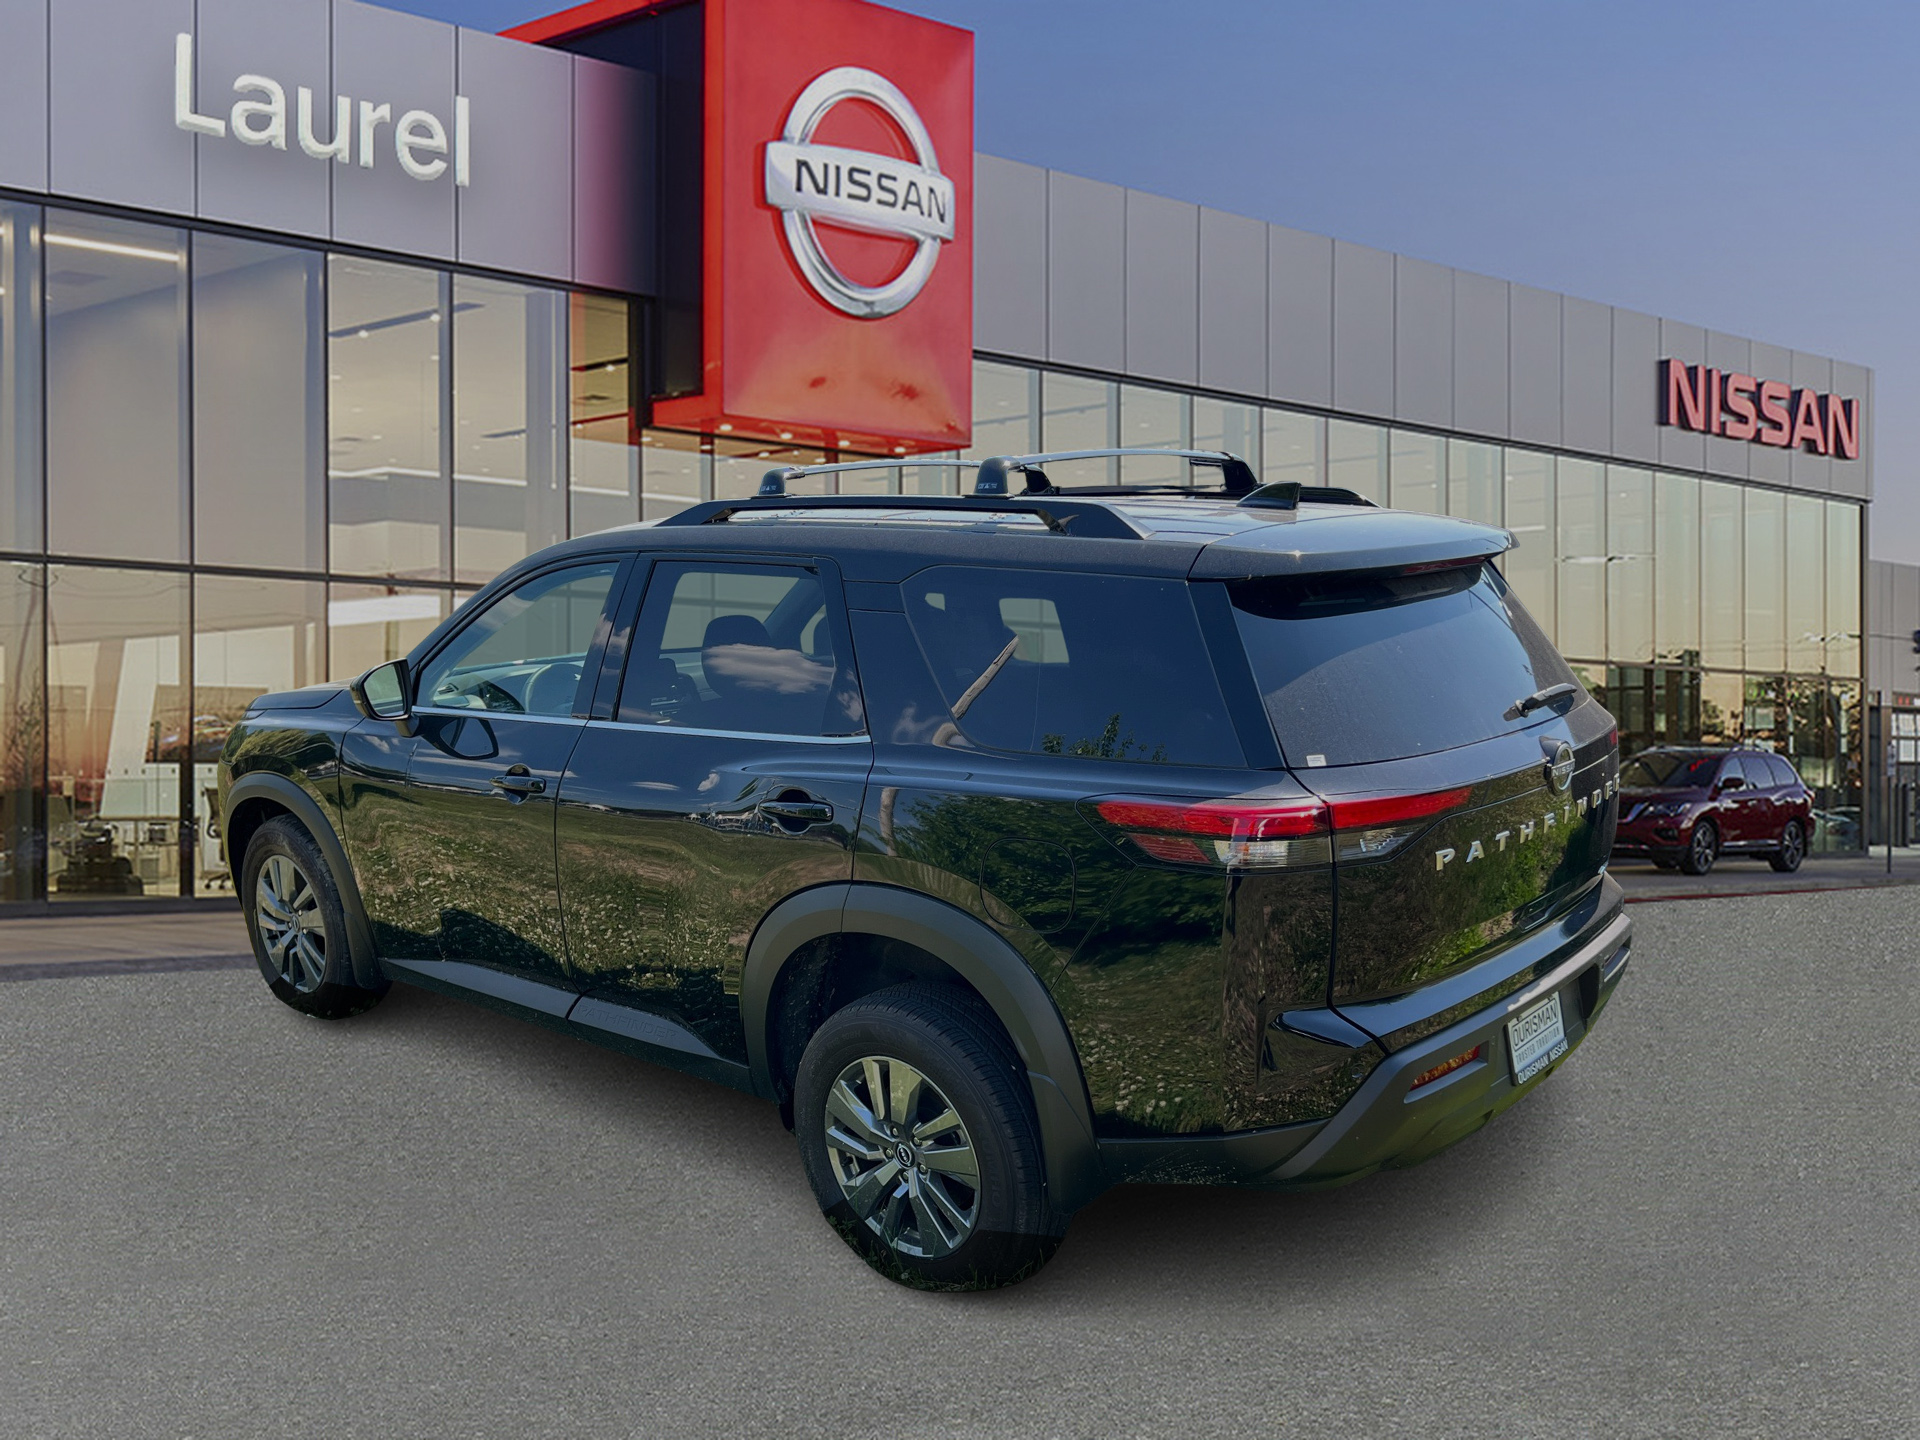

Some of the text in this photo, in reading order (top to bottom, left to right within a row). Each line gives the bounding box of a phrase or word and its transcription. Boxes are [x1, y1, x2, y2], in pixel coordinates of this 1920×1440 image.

[175, 33, 470, 188] Laurel
[795, 158, 947, 224] NISSAN
[1658, 358, 1860, 460] NISSAN
[1512, 1001, 1559, 1047] OURISMAN
[1517, 1037, 1569, 1085] OURISMAN NISSAN
